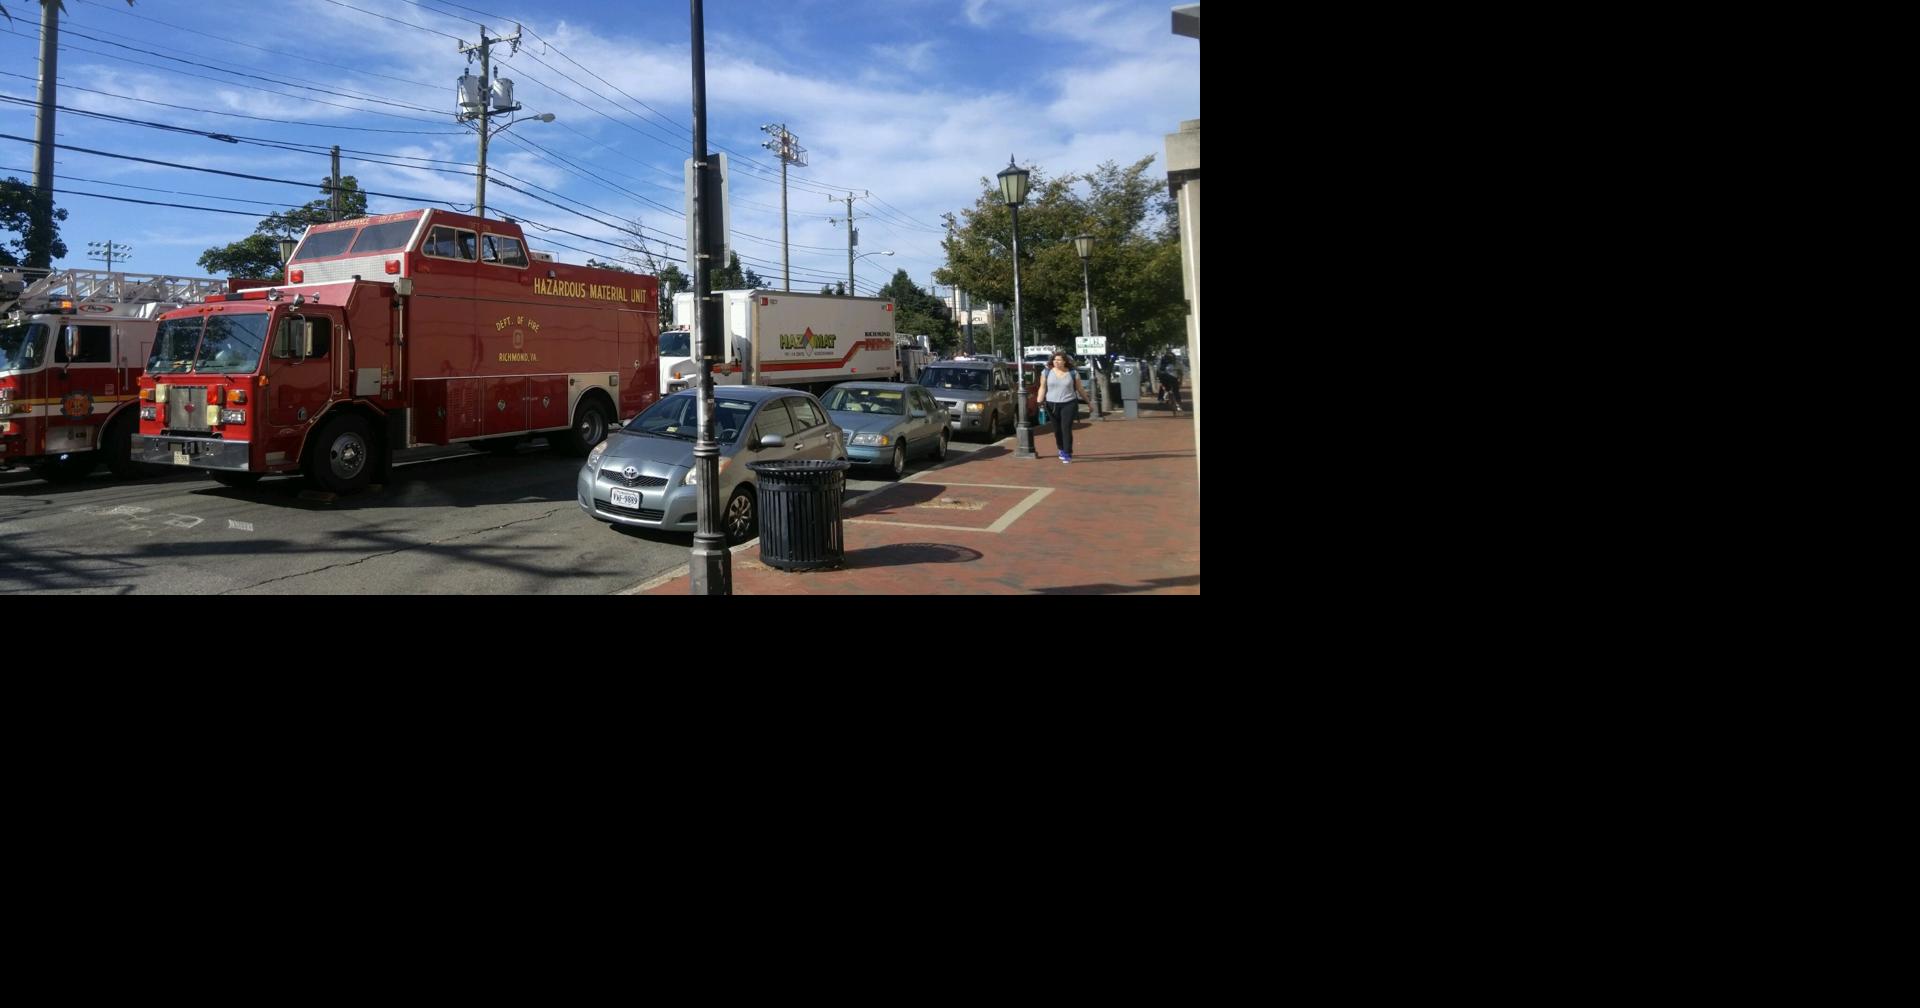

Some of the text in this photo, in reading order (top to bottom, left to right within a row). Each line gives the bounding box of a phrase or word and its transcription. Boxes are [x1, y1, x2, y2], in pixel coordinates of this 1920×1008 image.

[534, 278, 647, 303] HAZARDOUS MATERIAL UNIT
[496, 315, 540, 334] DEPT. OF FIRE
